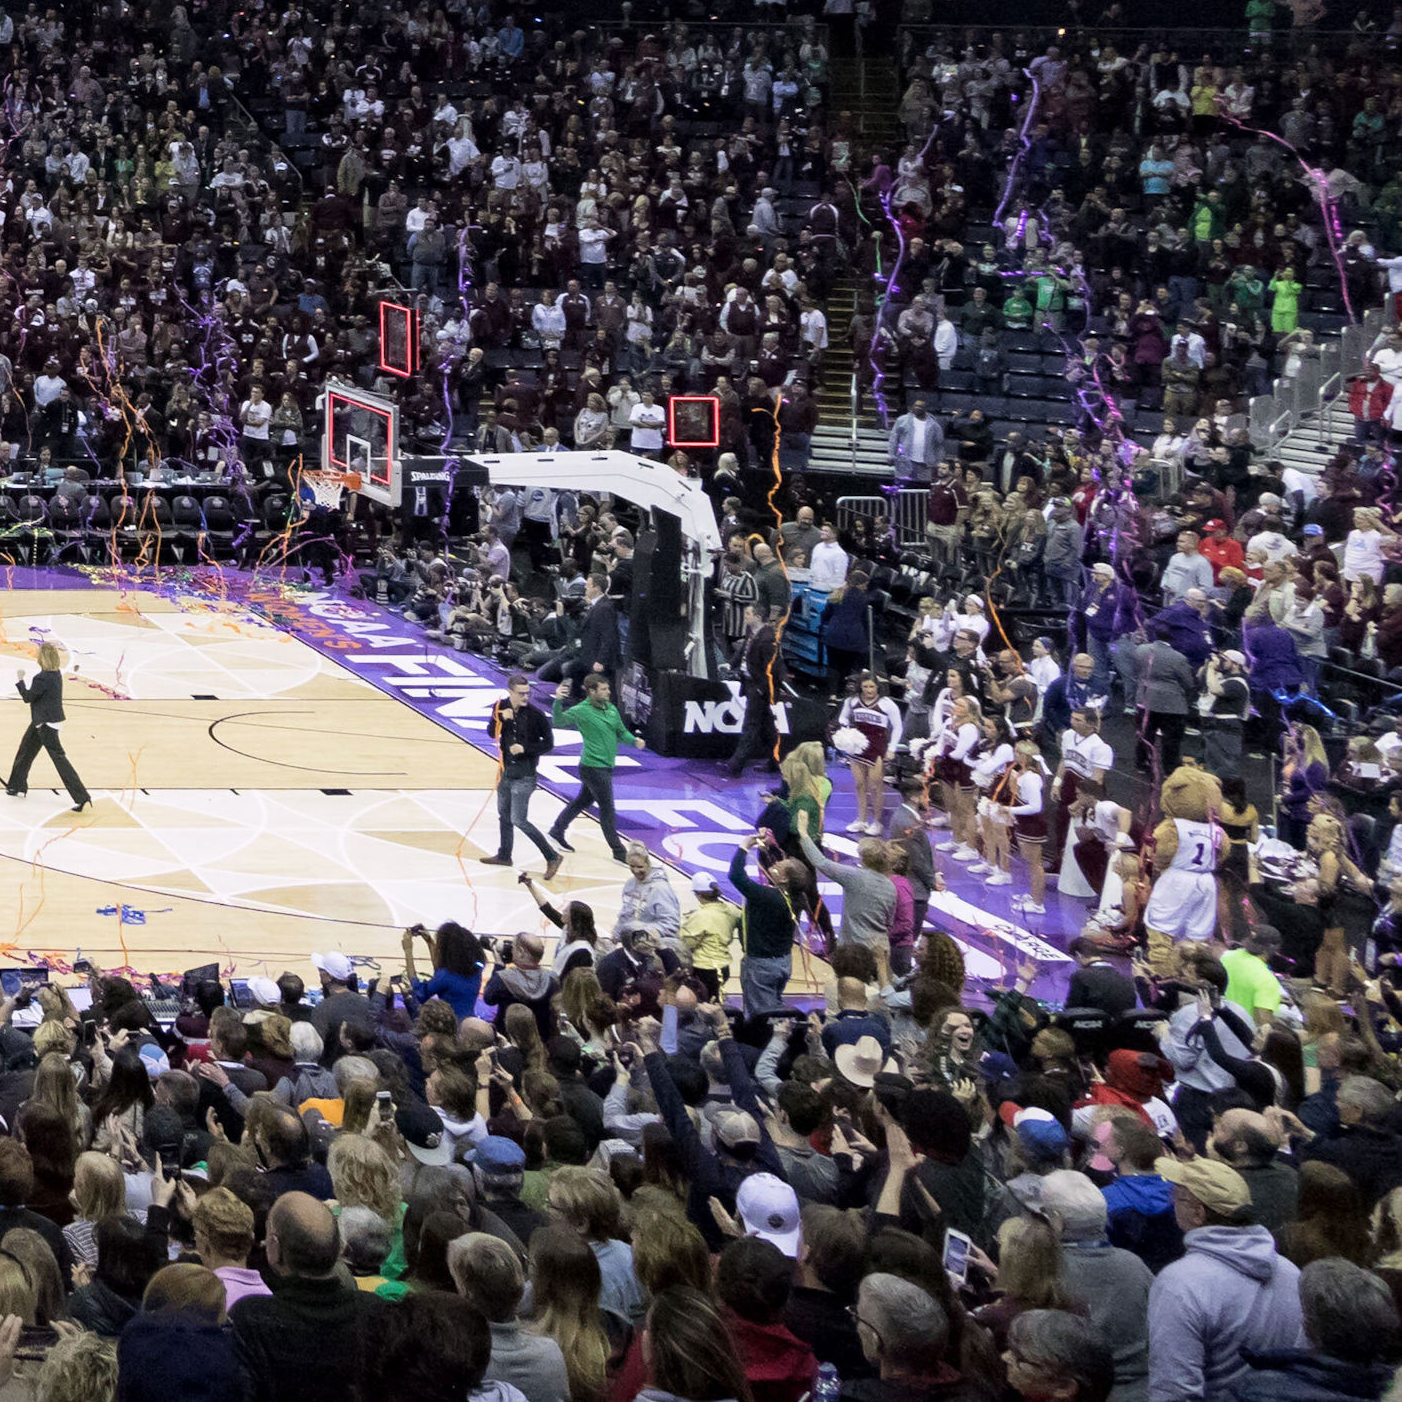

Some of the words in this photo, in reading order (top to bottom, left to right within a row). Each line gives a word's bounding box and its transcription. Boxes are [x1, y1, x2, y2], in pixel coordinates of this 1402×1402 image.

[410, 470, 450, 482] SPALDING
[685, 700, 792, 734] NCA
[1192, 842, 1205, 866] 1
